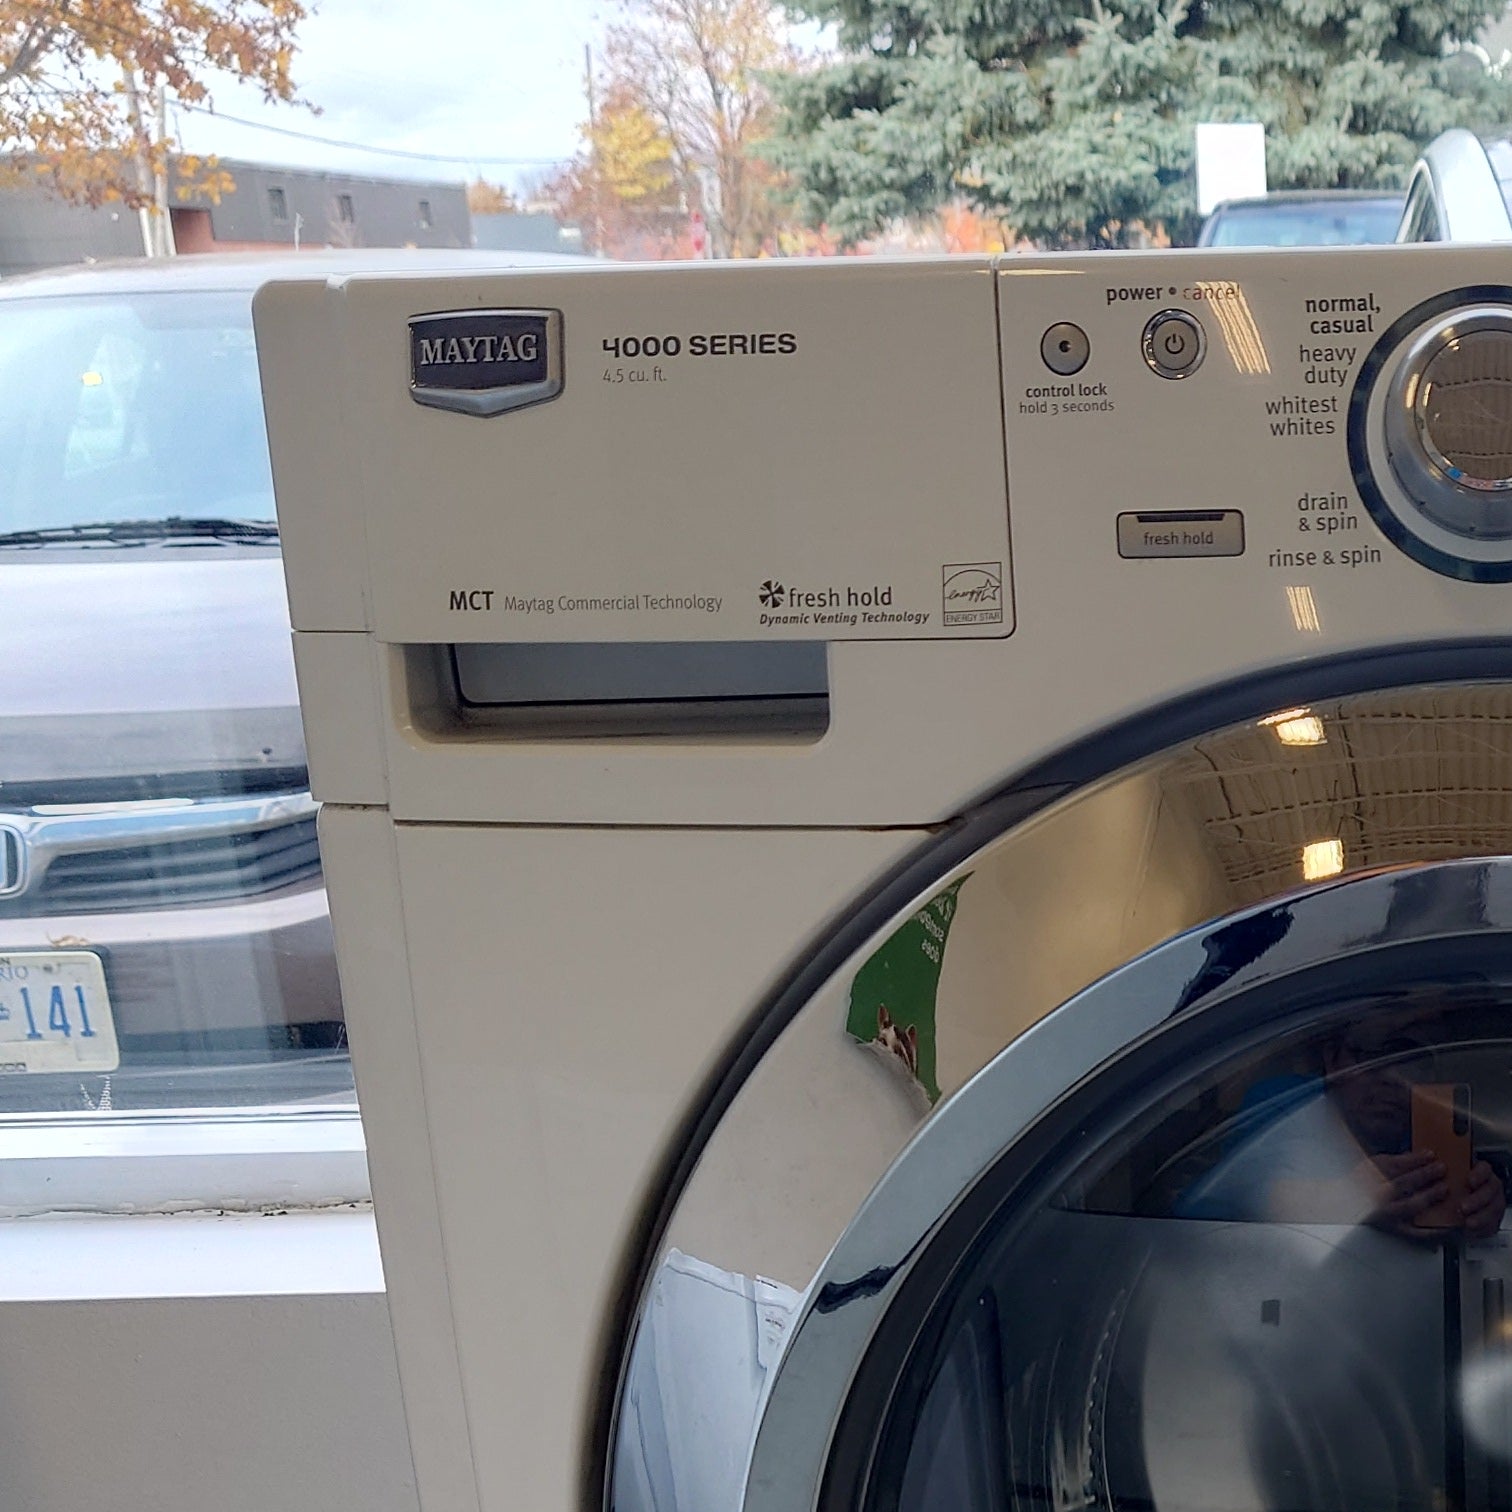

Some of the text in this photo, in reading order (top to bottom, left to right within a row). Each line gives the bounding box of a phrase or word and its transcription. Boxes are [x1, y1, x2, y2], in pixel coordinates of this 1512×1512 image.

[1106, 284, 1241, 306] power cancel
[1305, 292, 1381, 314] normal,
[1310, 314, 1374, 334] casual
[420, 334, 538, 366] MAYTAG
[602, 333, 798, 359] 4000 SERIES
[1300, 344, 1357, 366] heavy
[602, 365, 667, 384] 4.5 cu. ft.
[1304, 365, 1348, 388] duty
[1026, 382, 1107, 399] control lock
[1019, 399, 1115, 416] hold 3 seconds
[1265, 396, 1338, 415] whitest
[1270, 418, 1335, 436] whites
[1298, 492, 1348, 511] drain
[1298, 513, 1358, 535] & spin
[1144, 531, 1214, 546] fresh hold
[1268, 546, 1382, 567] rinse & spin
[450, 590, 723, 614] MCT Maytag Commercial Technology
[789, 586, 892, 608] fresh hold
[760, 611, 930, 627] Dynamic Venting Technology
